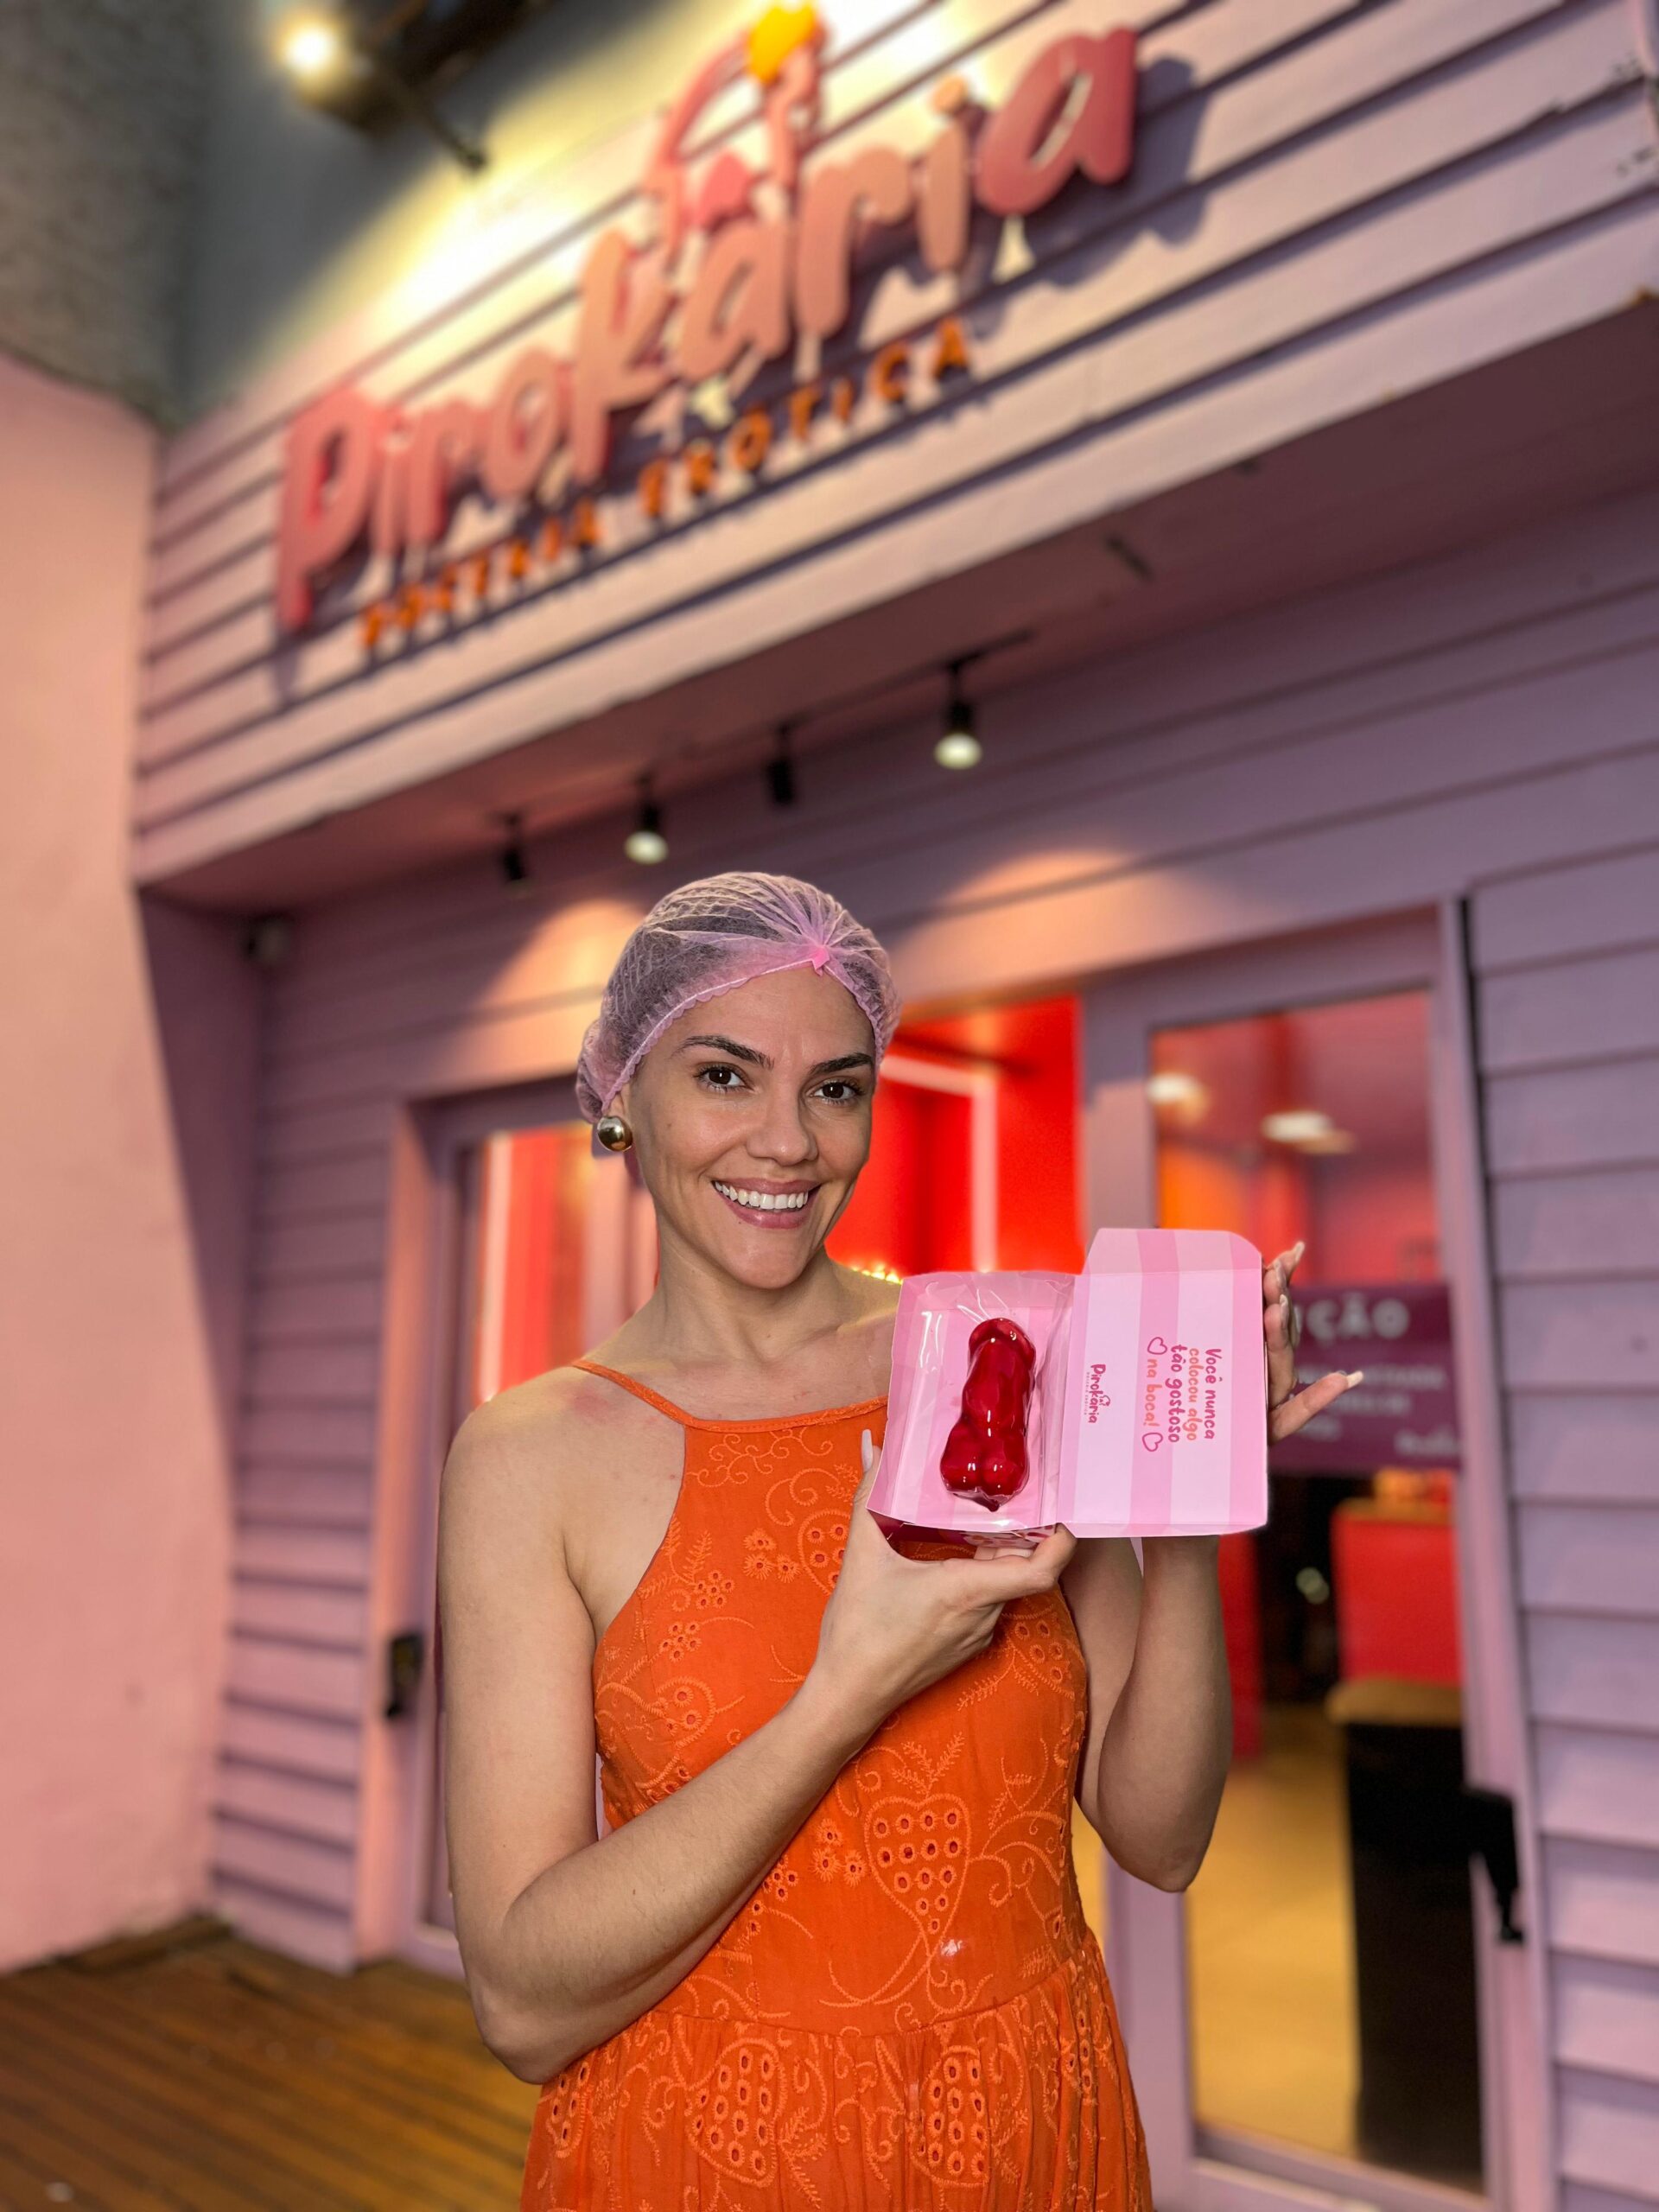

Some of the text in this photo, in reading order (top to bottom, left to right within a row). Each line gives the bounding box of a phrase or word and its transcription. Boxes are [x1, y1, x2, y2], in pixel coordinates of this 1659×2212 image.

[1294, 1294, 1410, 1346] ÇÃO
[1143, 1358, 1163, 1427] na boca!
[1165, 1344, 1188, 1443] tão gostoso
[1182, 1348, 1205, 1440] colocou algo
[1204, 1349, 1223, 1440] Você nunca
